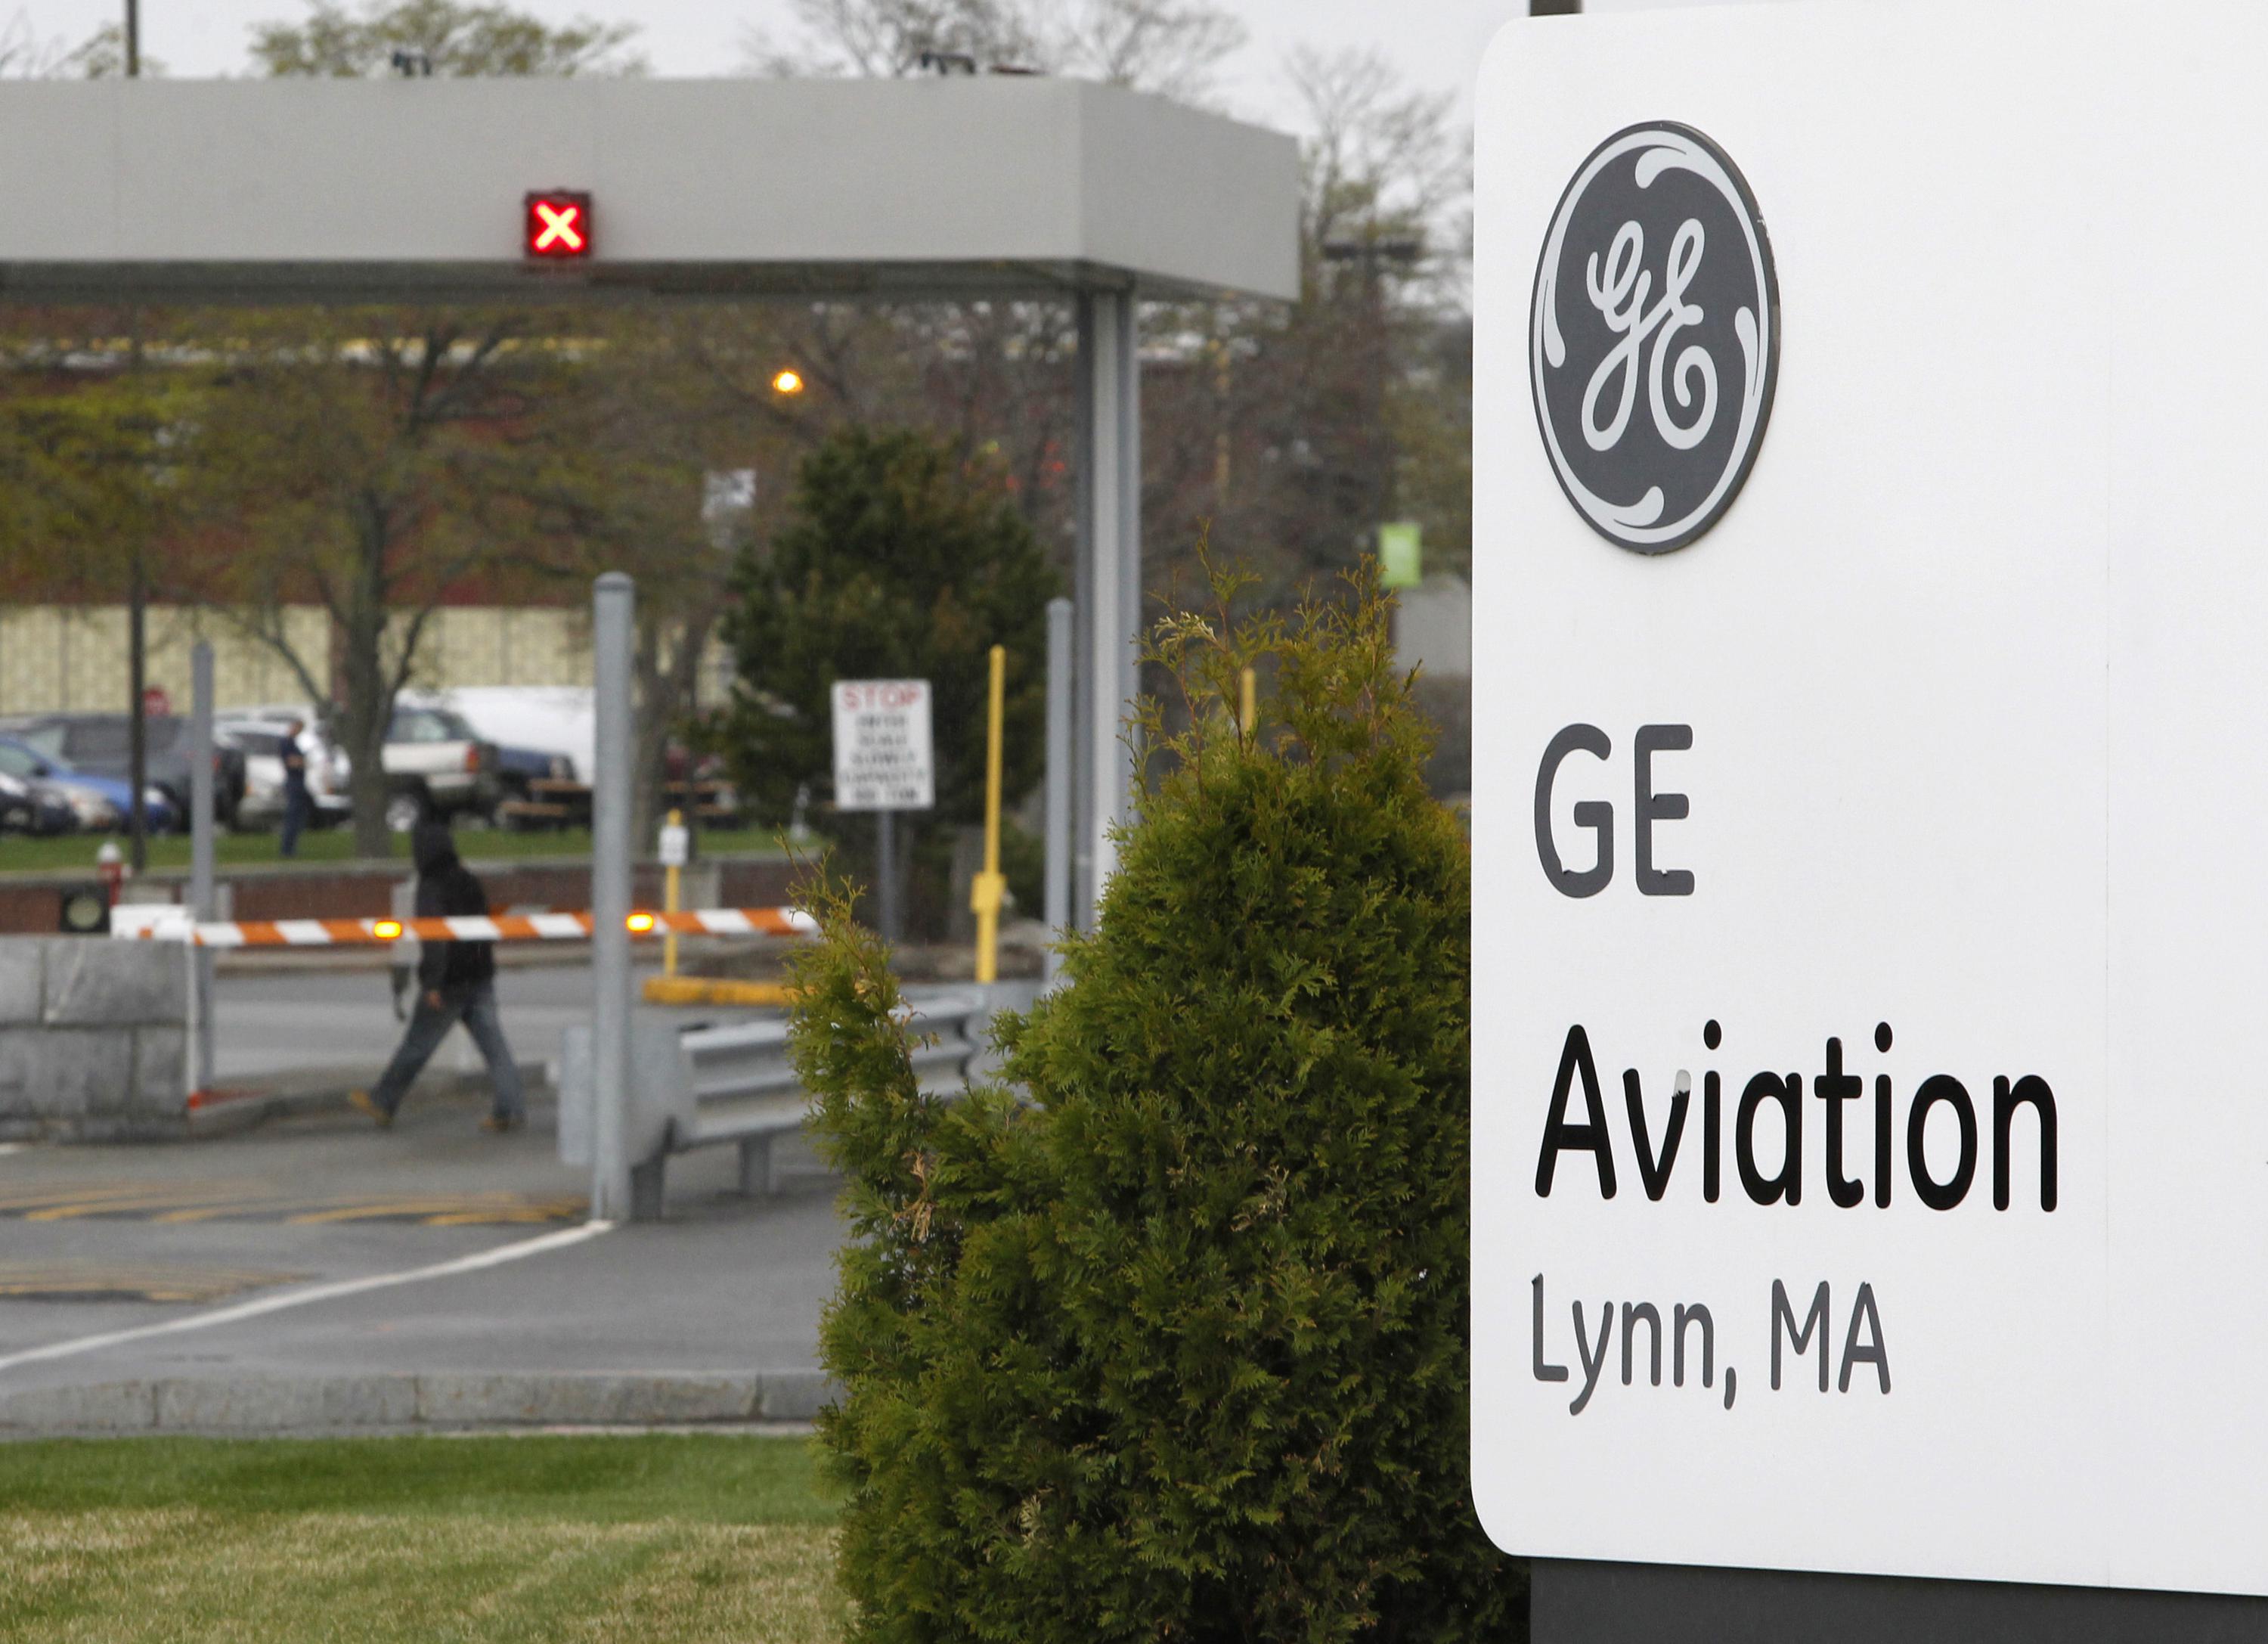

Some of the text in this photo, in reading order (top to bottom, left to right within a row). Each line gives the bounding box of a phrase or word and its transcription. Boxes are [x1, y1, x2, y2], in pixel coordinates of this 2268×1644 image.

[1581, 218, 1718, 451] GE
[841, 682, 921, 713] STOP
[1534, 723, 1695, 899] GE
[1535, 1019, 2058, 1213] Aviation
[1531, 1273, 1892, 1416] Lynn, MA
